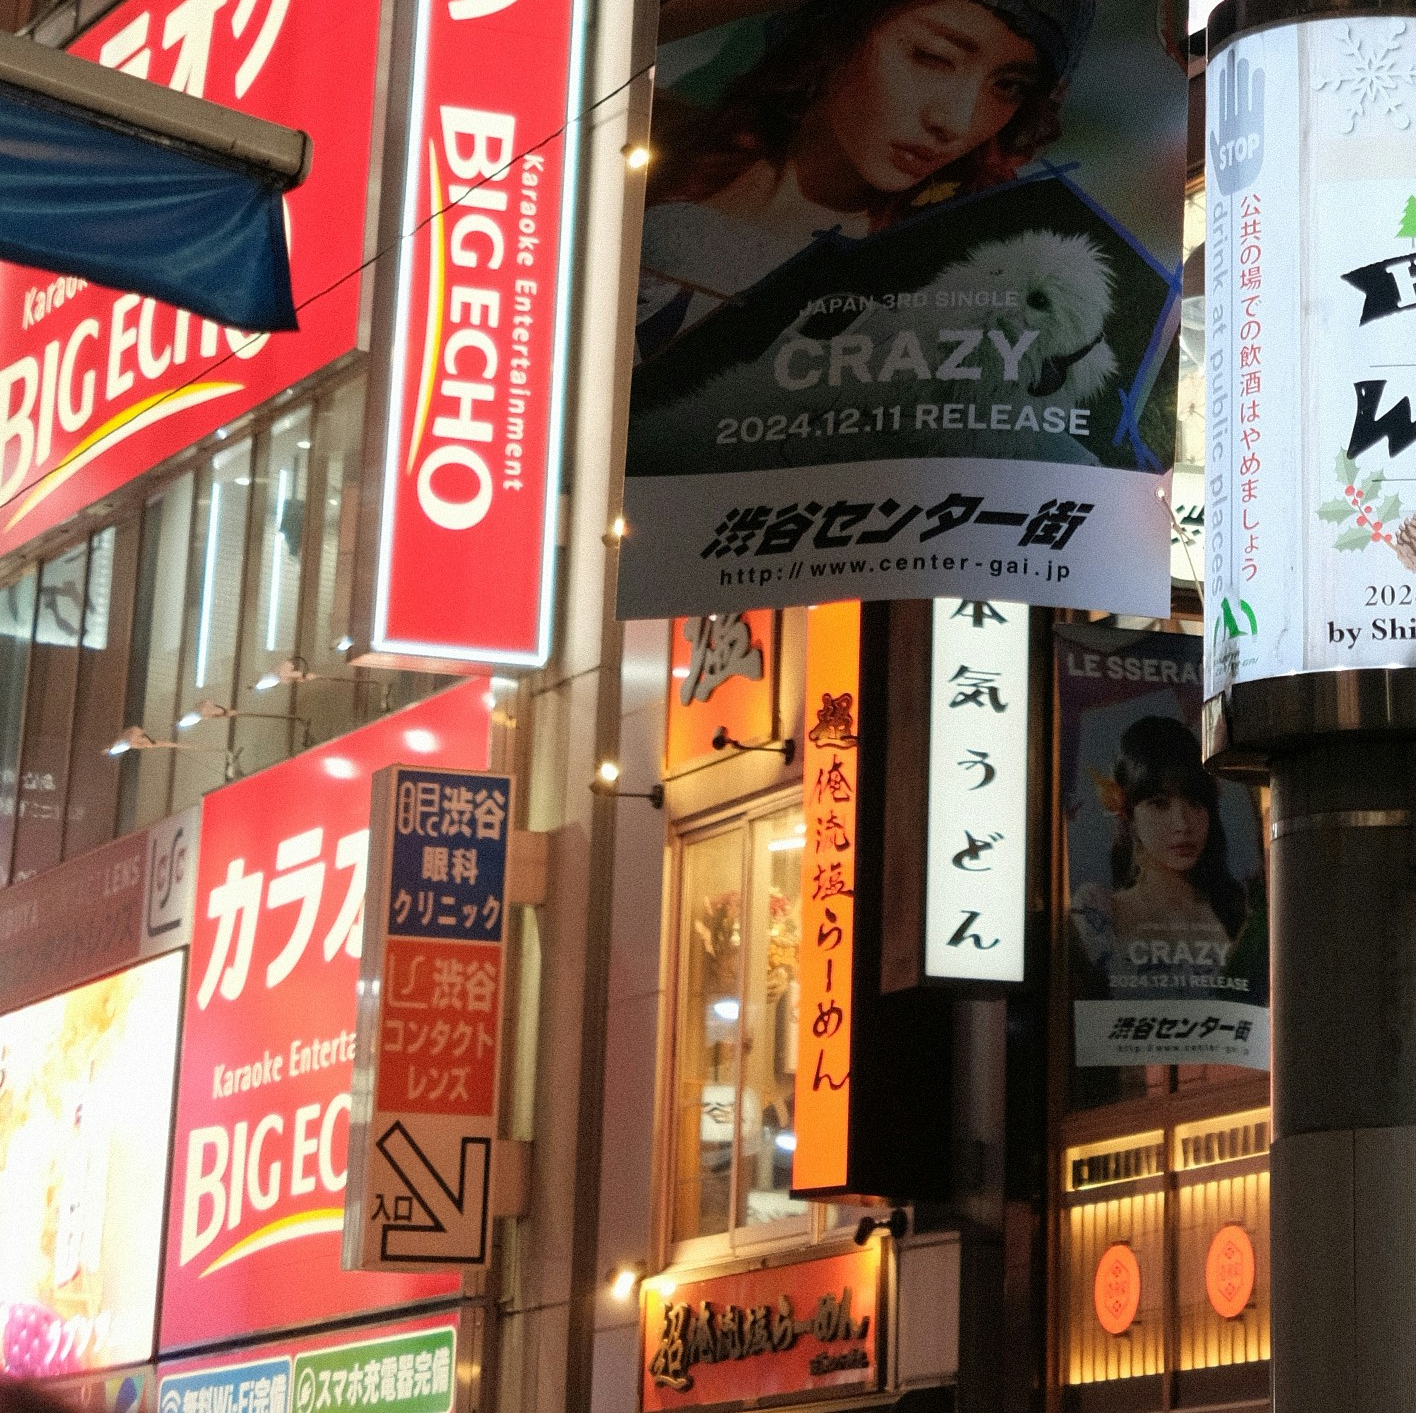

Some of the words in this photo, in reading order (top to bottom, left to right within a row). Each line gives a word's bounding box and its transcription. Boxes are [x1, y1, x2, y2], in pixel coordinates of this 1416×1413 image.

[1219, 134, 1260, 171] STOP
[439, 105, 516, 270] BIG
[515, 153, 545, 268] Karaoke
[1211, 200, 1229, 290] drink
[802, 294, 875, 316] JAPAN
[882, 291, 928, 311] 3RD
[938, 289, 1020, 309] SINGLE
[1210, 303, 1226, 343] at
[773, 328, 1041, 392] CRAZY
[417, 285, 500, 530] ECHO
[502, 278, 538, 491] Entertainment
[1209, 349, 1229, 464] public
[1240, 192, 1263, 583] 公共の場での飲酒はやめましょう
[716, 405, 901, 445] 2024.12.11
[915, 403, 1091, 437] RELEASE
[700, 493, 1096, 560] 渋谷センター街
[1209, 477, 1229, 598] places
[719, 556, 1071, 587] http://www.center-gai.jp
[1327, 620, 1361, 650] by
[1067, 653, 1101, 678] LE
[441, 787, 506, 841] 渋谷
[422, 846, 479, 885] 眼科
[393, 888, 501, 931] クリニック
[1129, 940, 1231, 967] CRAZY
[431, 957, 498, 1013] 渋谷
[1190, 976, 1251, 993] RELEASE
[385, 1020, 494, 1060] コンタクト
[1109, 1015, 1254, 1043] 渋谷センター街
[212, 1048, 283, 1100] Karaoke
[407, 1064, 469, 1102] レンズ
[179, 1113, 284, 1267] BIG
[371, 1191, 414, 1223] 入口
[316, 1346, 450, 1411] スマホ充電器完備
